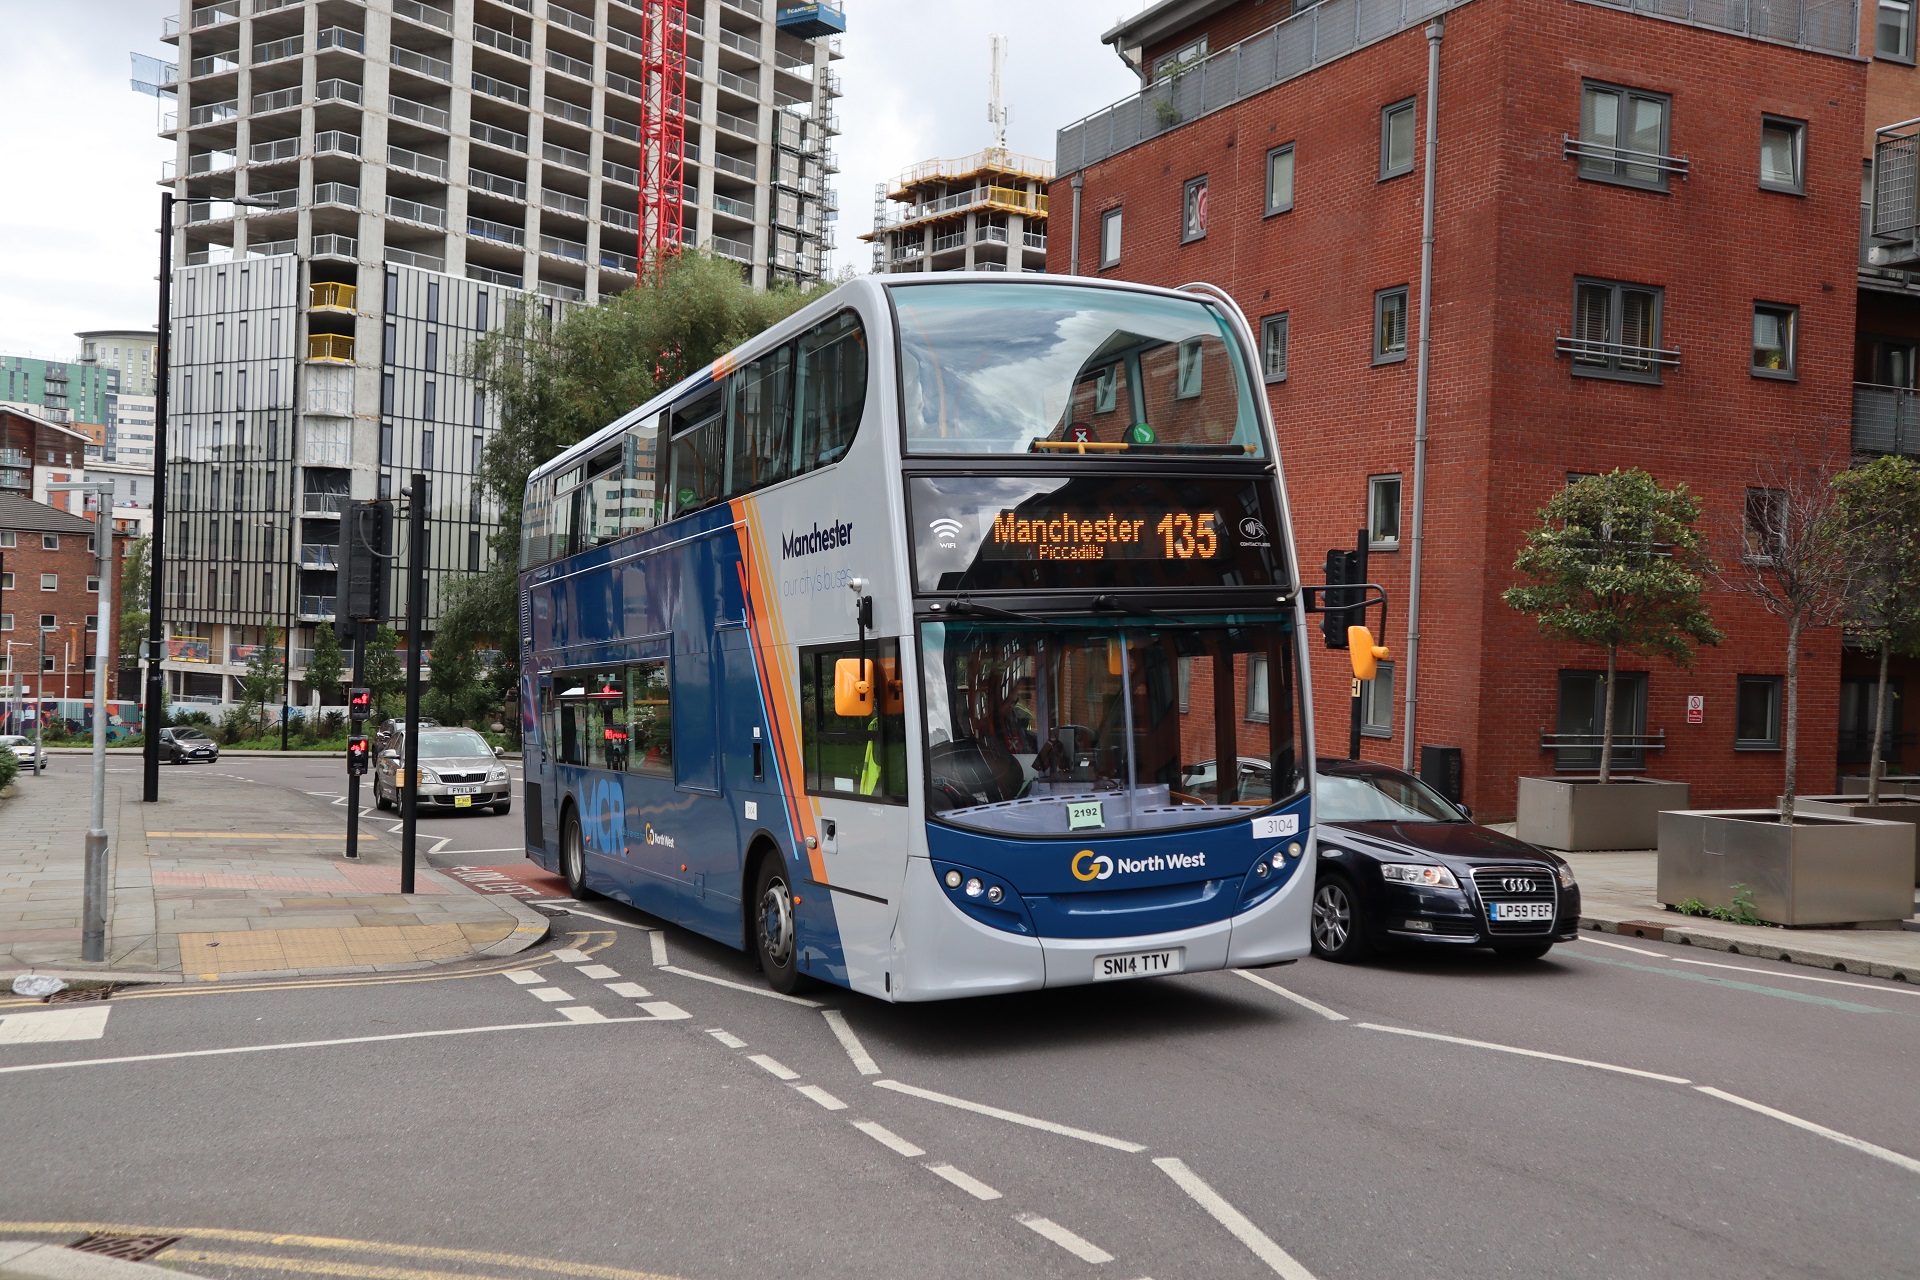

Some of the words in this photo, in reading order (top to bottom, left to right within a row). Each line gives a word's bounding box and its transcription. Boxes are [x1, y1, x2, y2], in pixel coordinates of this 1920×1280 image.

[782, 519, 853, 560] Manchester
[994, 512, 1145, 543] Manchester
[1157, 513, 1217, 558] 135
[1039, 544, 1104, 559] Piccadilly
[783, 579, 799, 597] our
[799, 568, 823, 601] city's
[578, 775, 627, 858] MCR
[1074, 807, 1098, 818] 2192
[1267, 818, 1294, 833] 3104
[654, 832, 665, 846] North
[664, 834, 675, 849] West
[1117, 855, 1165, 874] North
[1165, 851, 1206, 870] West
[1498, 904, 1528, 918] LP59
[1530, 904, 1550, 917] FEF
[1103, 956, 1137, 975] SN14
[1141, 953, 1170, 971] TTV
